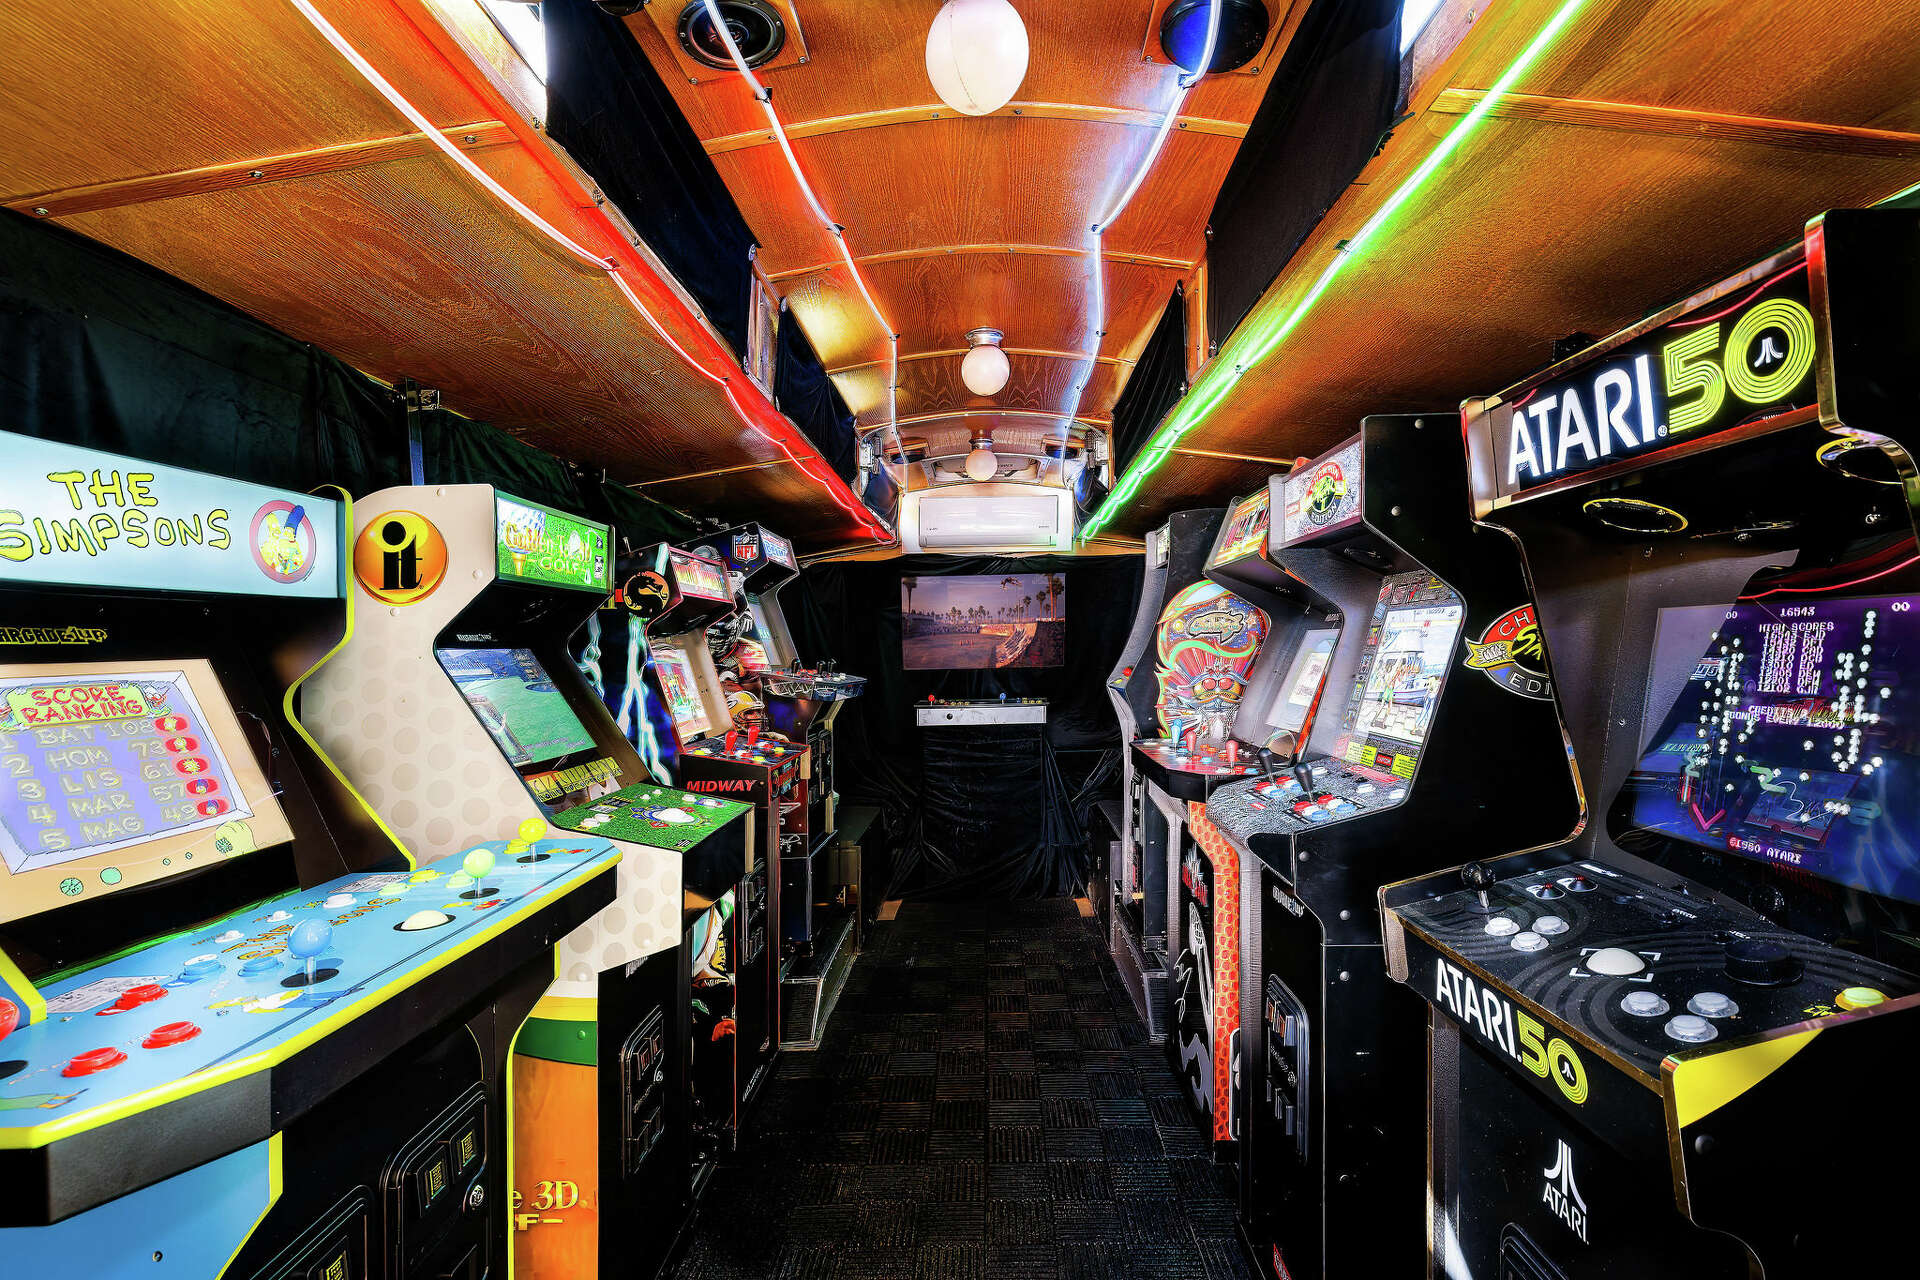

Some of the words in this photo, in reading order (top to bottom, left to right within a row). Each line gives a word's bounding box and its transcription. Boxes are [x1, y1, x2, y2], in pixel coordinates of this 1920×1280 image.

[1508, 354, 1658, 485] ATARI
[1664, 298, 1816, 434] 50
[47, 469, 158, 510] THE
[0, 508, 231, 562] SIMPSONS
[736, 547, 758, 561] NFL
[1759, 623, 1786, 633] HIGH
[1791, 622, 1835, 632] SCORES
[31, 685, 126, 707] SCORE
[20, 699, 144, 724] RANKING
[36, 725, 94, 745] BAT
[5, 756, 34, 775] 2
[48, 748, 110, 770] HOM
[20, 782, 44, 800] 3
[61, 770, 120, 794] LIS
[686, 779, 759, 793] MIDWAY
[30, 807, 54, 824] 4
[70, 793, 133, 817] MAR
[152, 783, 185, 801] 57
[42, 831, 69, 850] 5
[82, 816, 142, 842] MAG
[1766, 847, 1802, 865] ATARI
[1436, 957, 1517, 1062] ATARI
[1516, 1008, 1589, 1105] 50
[531, 1180, 579, 1211] 3D
[1542, 1182, 1589, 1245] ATARI
